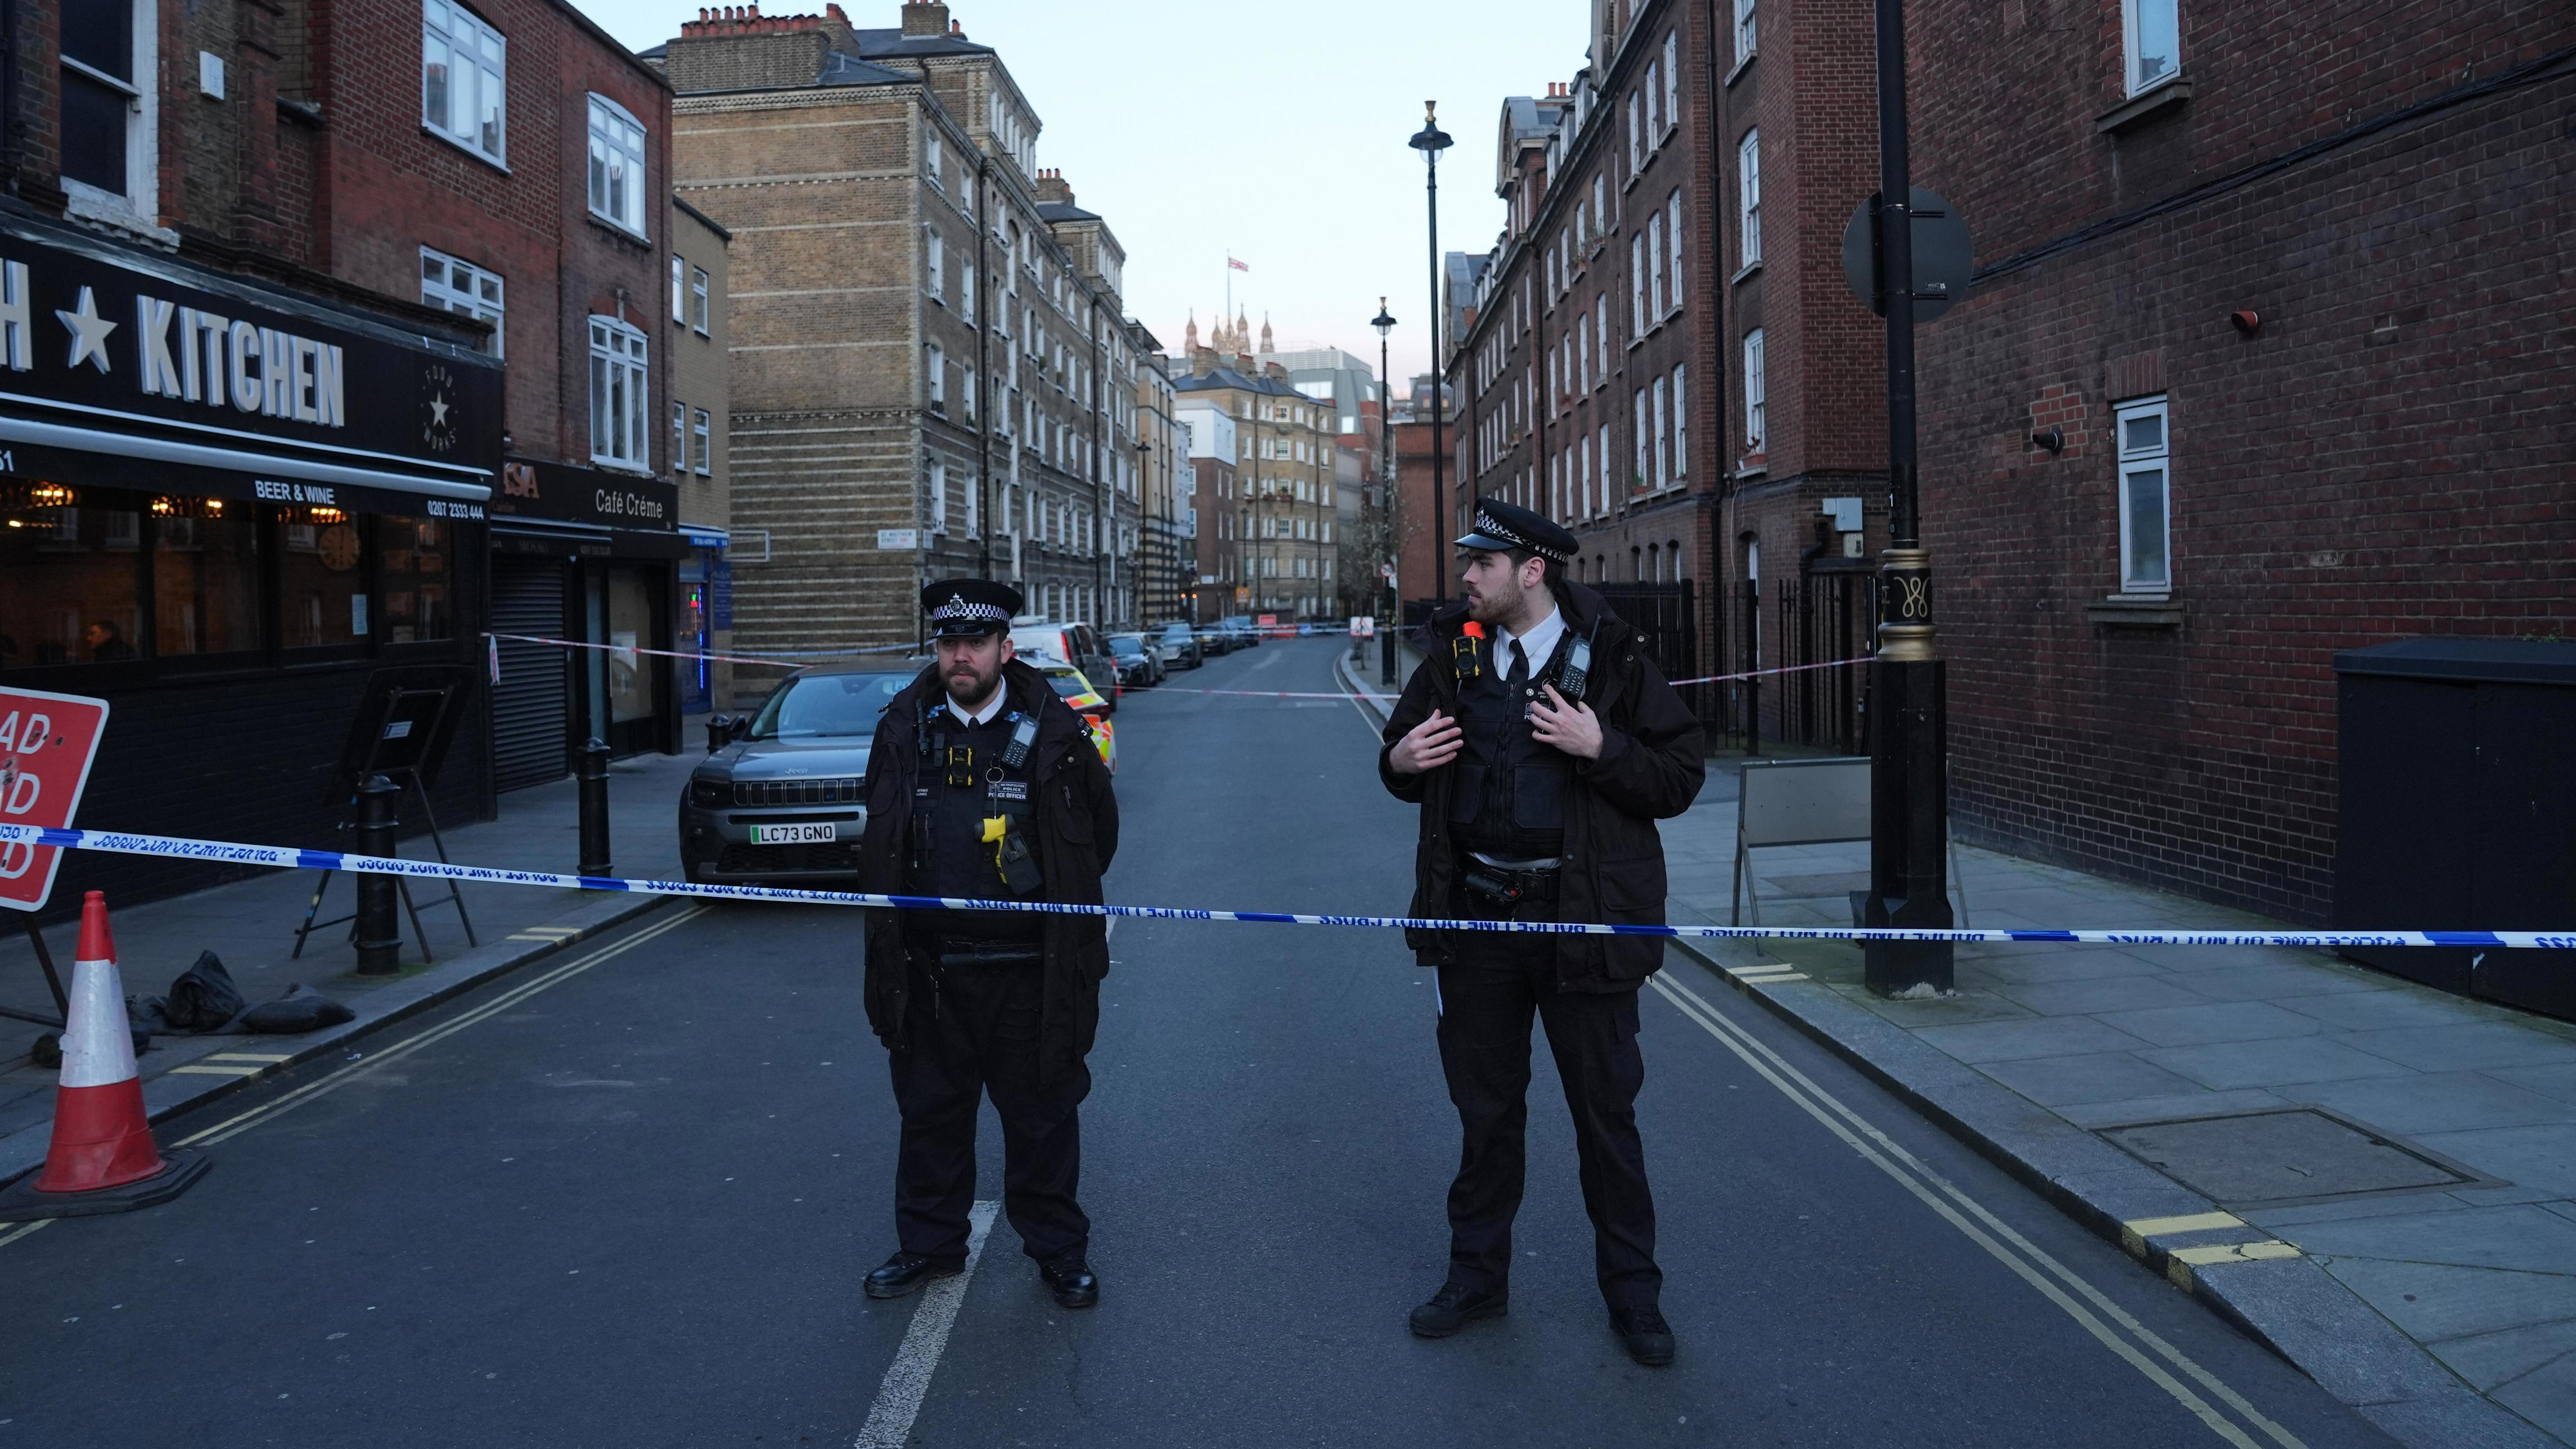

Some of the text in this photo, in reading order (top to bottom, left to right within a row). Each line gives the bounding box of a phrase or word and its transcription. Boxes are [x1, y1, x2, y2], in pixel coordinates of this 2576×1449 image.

[136, 294, 344, 428] KITCHEN
[425, 364, 452, 388] FOOD
[424, 427, 456, 452] WORKS
[255, 480, 336, 505] BEER & WINE
[596, 489, 663, 519] Café Créme
[427, 500, 484, 520] 0207 2333 444
[0, 710, 51, 754] AD
[0, 768, 40, 815] D
[761, 826, 832, 842] LC73 GNO
